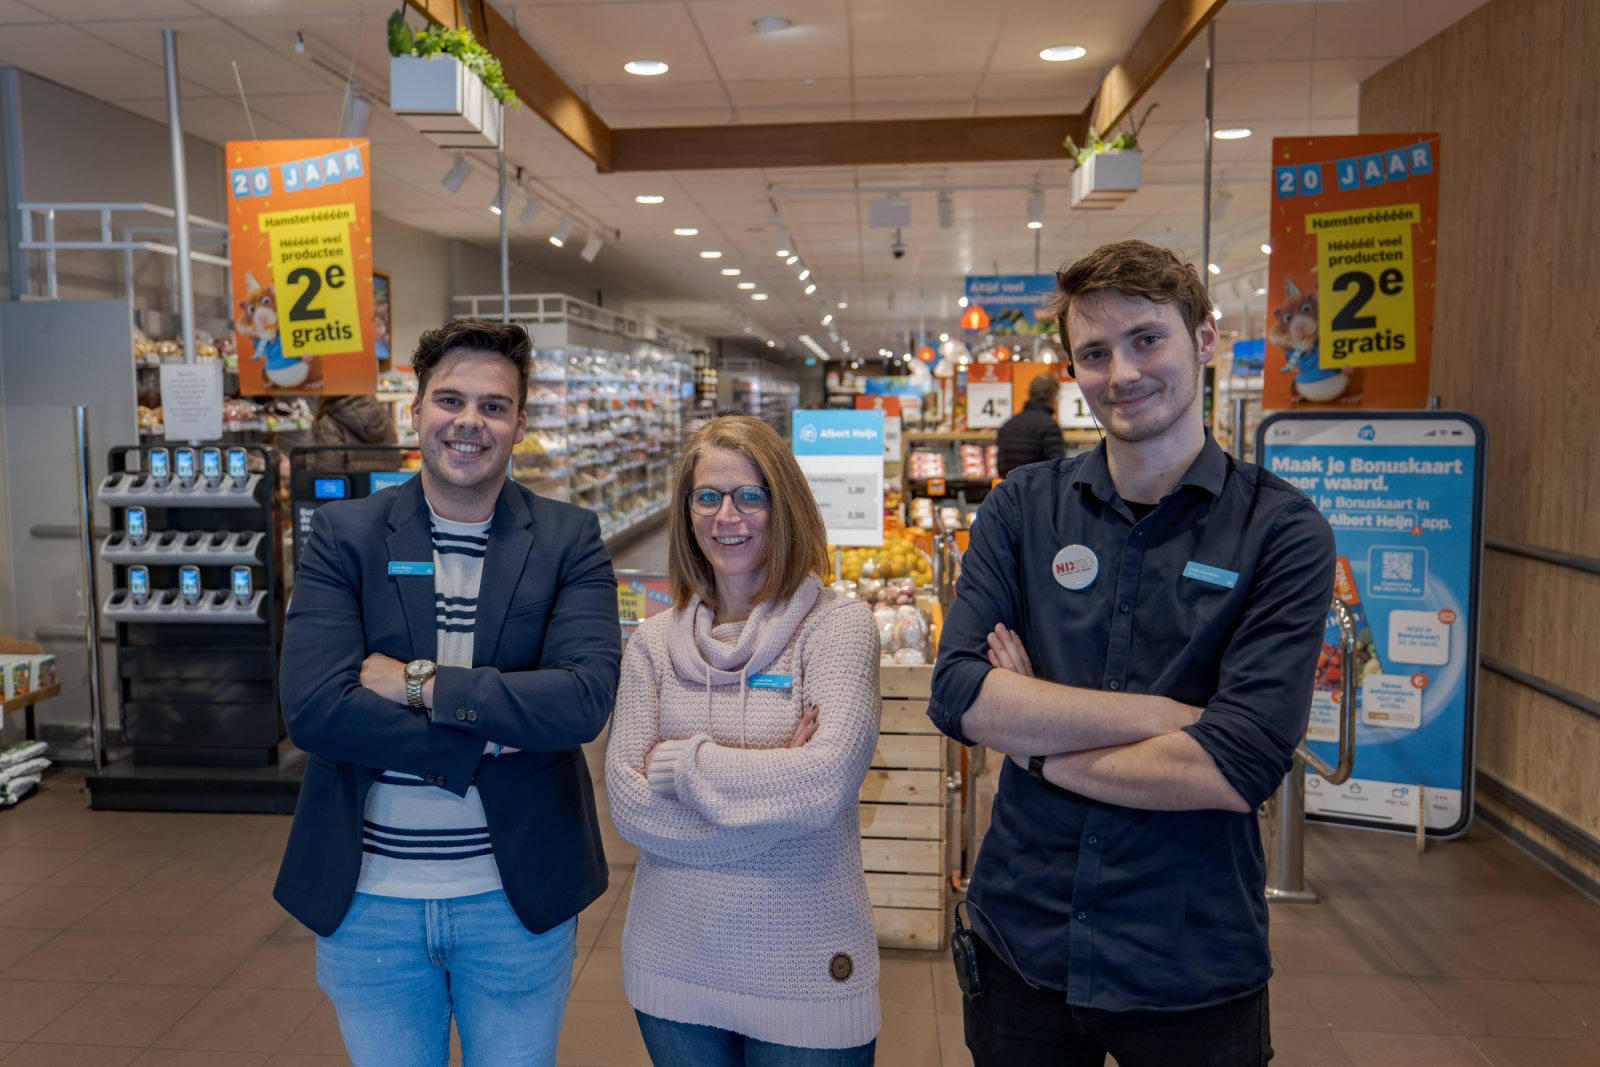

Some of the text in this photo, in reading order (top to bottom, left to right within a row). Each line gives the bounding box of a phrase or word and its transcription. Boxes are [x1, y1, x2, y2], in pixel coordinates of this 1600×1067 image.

[234, 152, 361, 195] 20 JAAR
[1279, 148, 1430, 193] 20 JAAR
[322, 232, 342, 244] veel
[1378, 235, 1402, 247] veel
[281, 247, 344, 263] producten
[1328, 250, 1403, 268] producten
[292, 321, 353, 349] gratis
[1332, 330, 1406, 360] gratis
[820, 428, 850, 439] Albert
[852, 428, 878, 440] Heijn
[1271, 456, 1463, 476] Maak je Bonuskaart
[1283, 475, 1389, 491] eer waard.
[1319, 495, 1331, 511] je
[1336, 496, 1412, 510] Bonuskaart
[1417, 497, 1430, 511] in
[1328, 514, 1451, 531] Albert Heijn app.
